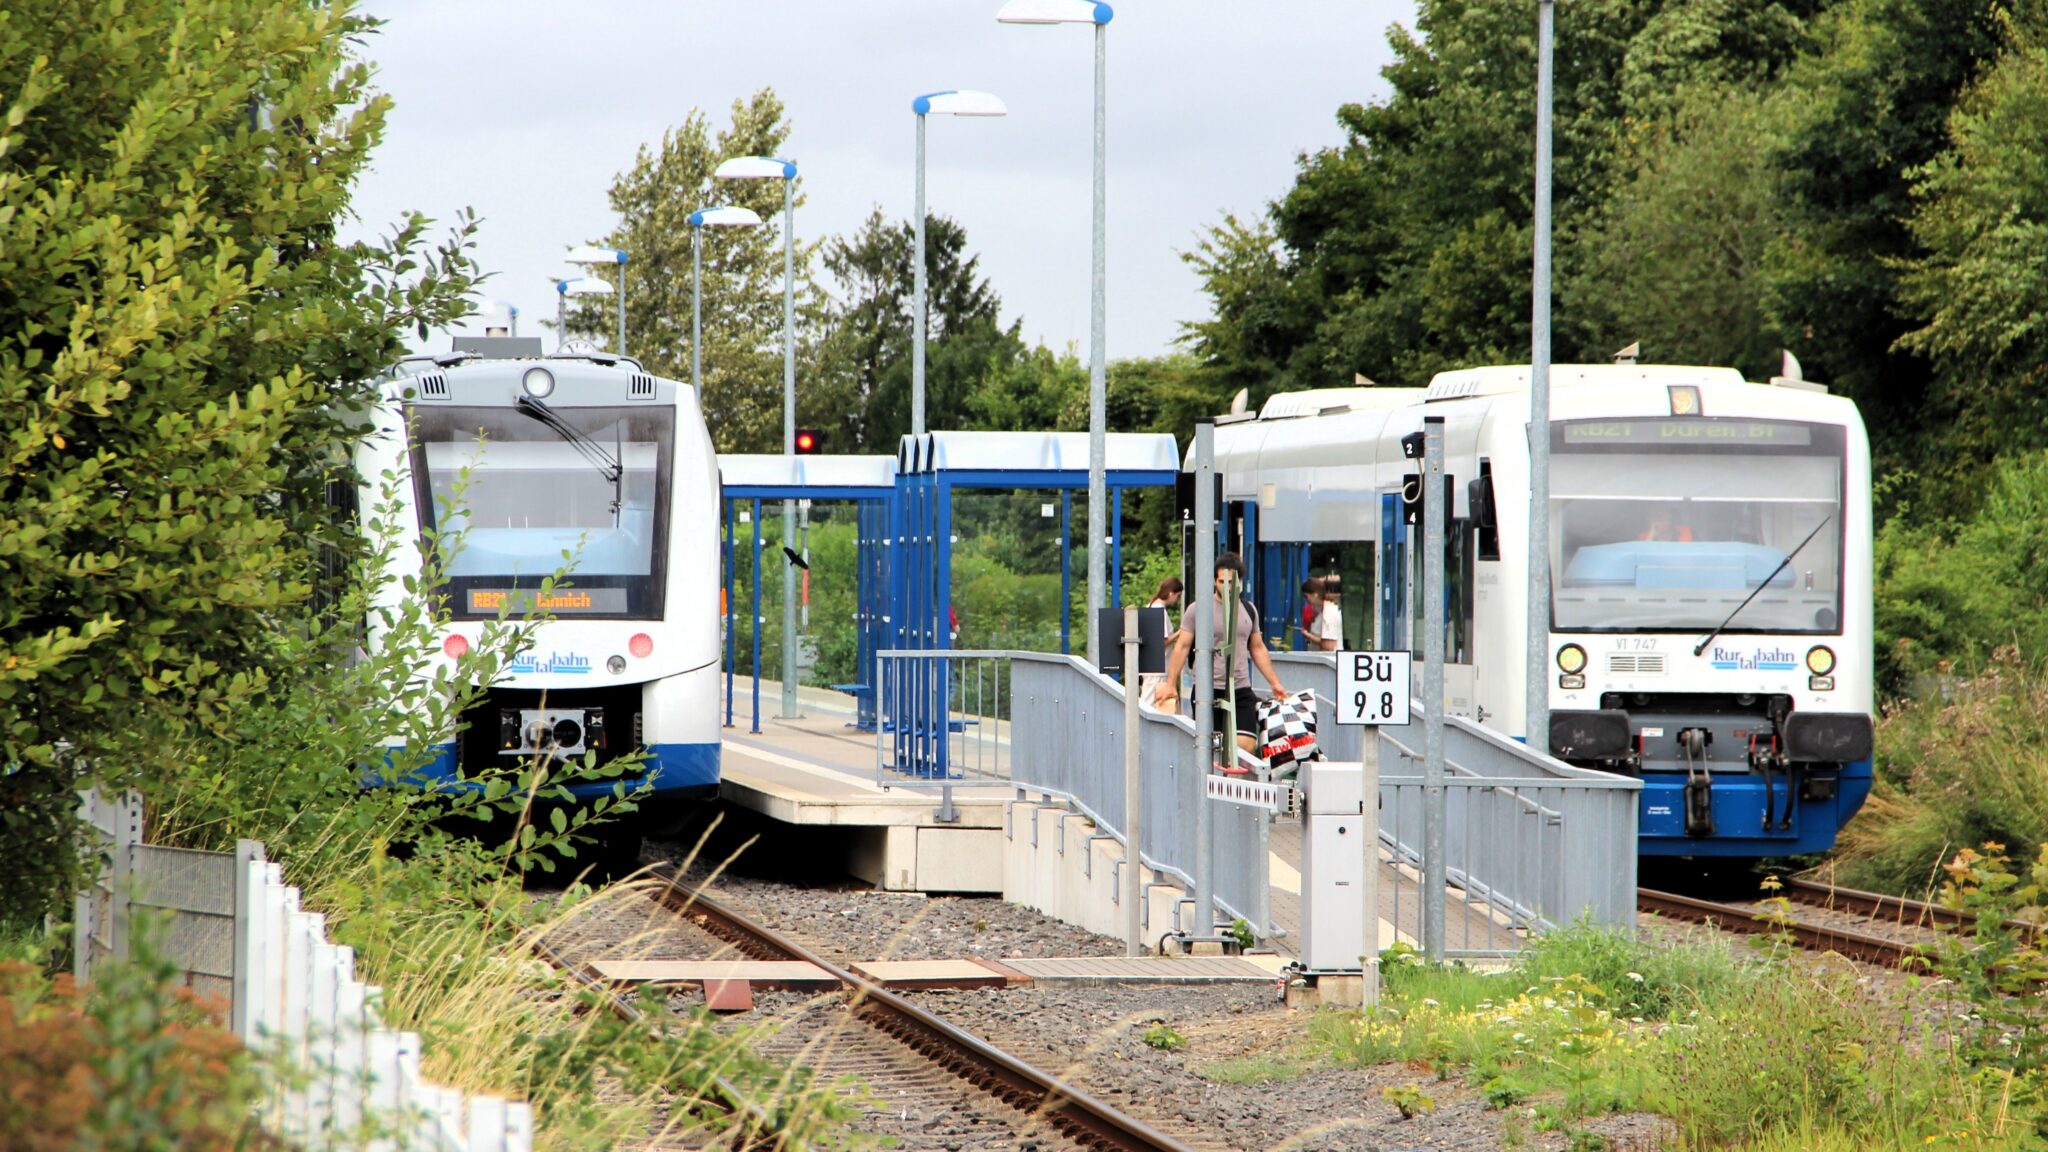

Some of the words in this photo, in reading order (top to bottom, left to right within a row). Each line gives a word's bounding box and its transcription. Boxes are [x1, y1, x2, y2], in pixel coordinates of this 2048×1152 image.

[1405, 443, 1414, 455] 2
[1182, 508, 1191, 520] 2
[1408, 511, 1417, 524] 4
[1615, 638, 1628, 650] VT
[1633, 638, 1658, 650] 747
[1354, 654, 1392, 682] Bü
[1354, 690, 1393, 720] 9,8
